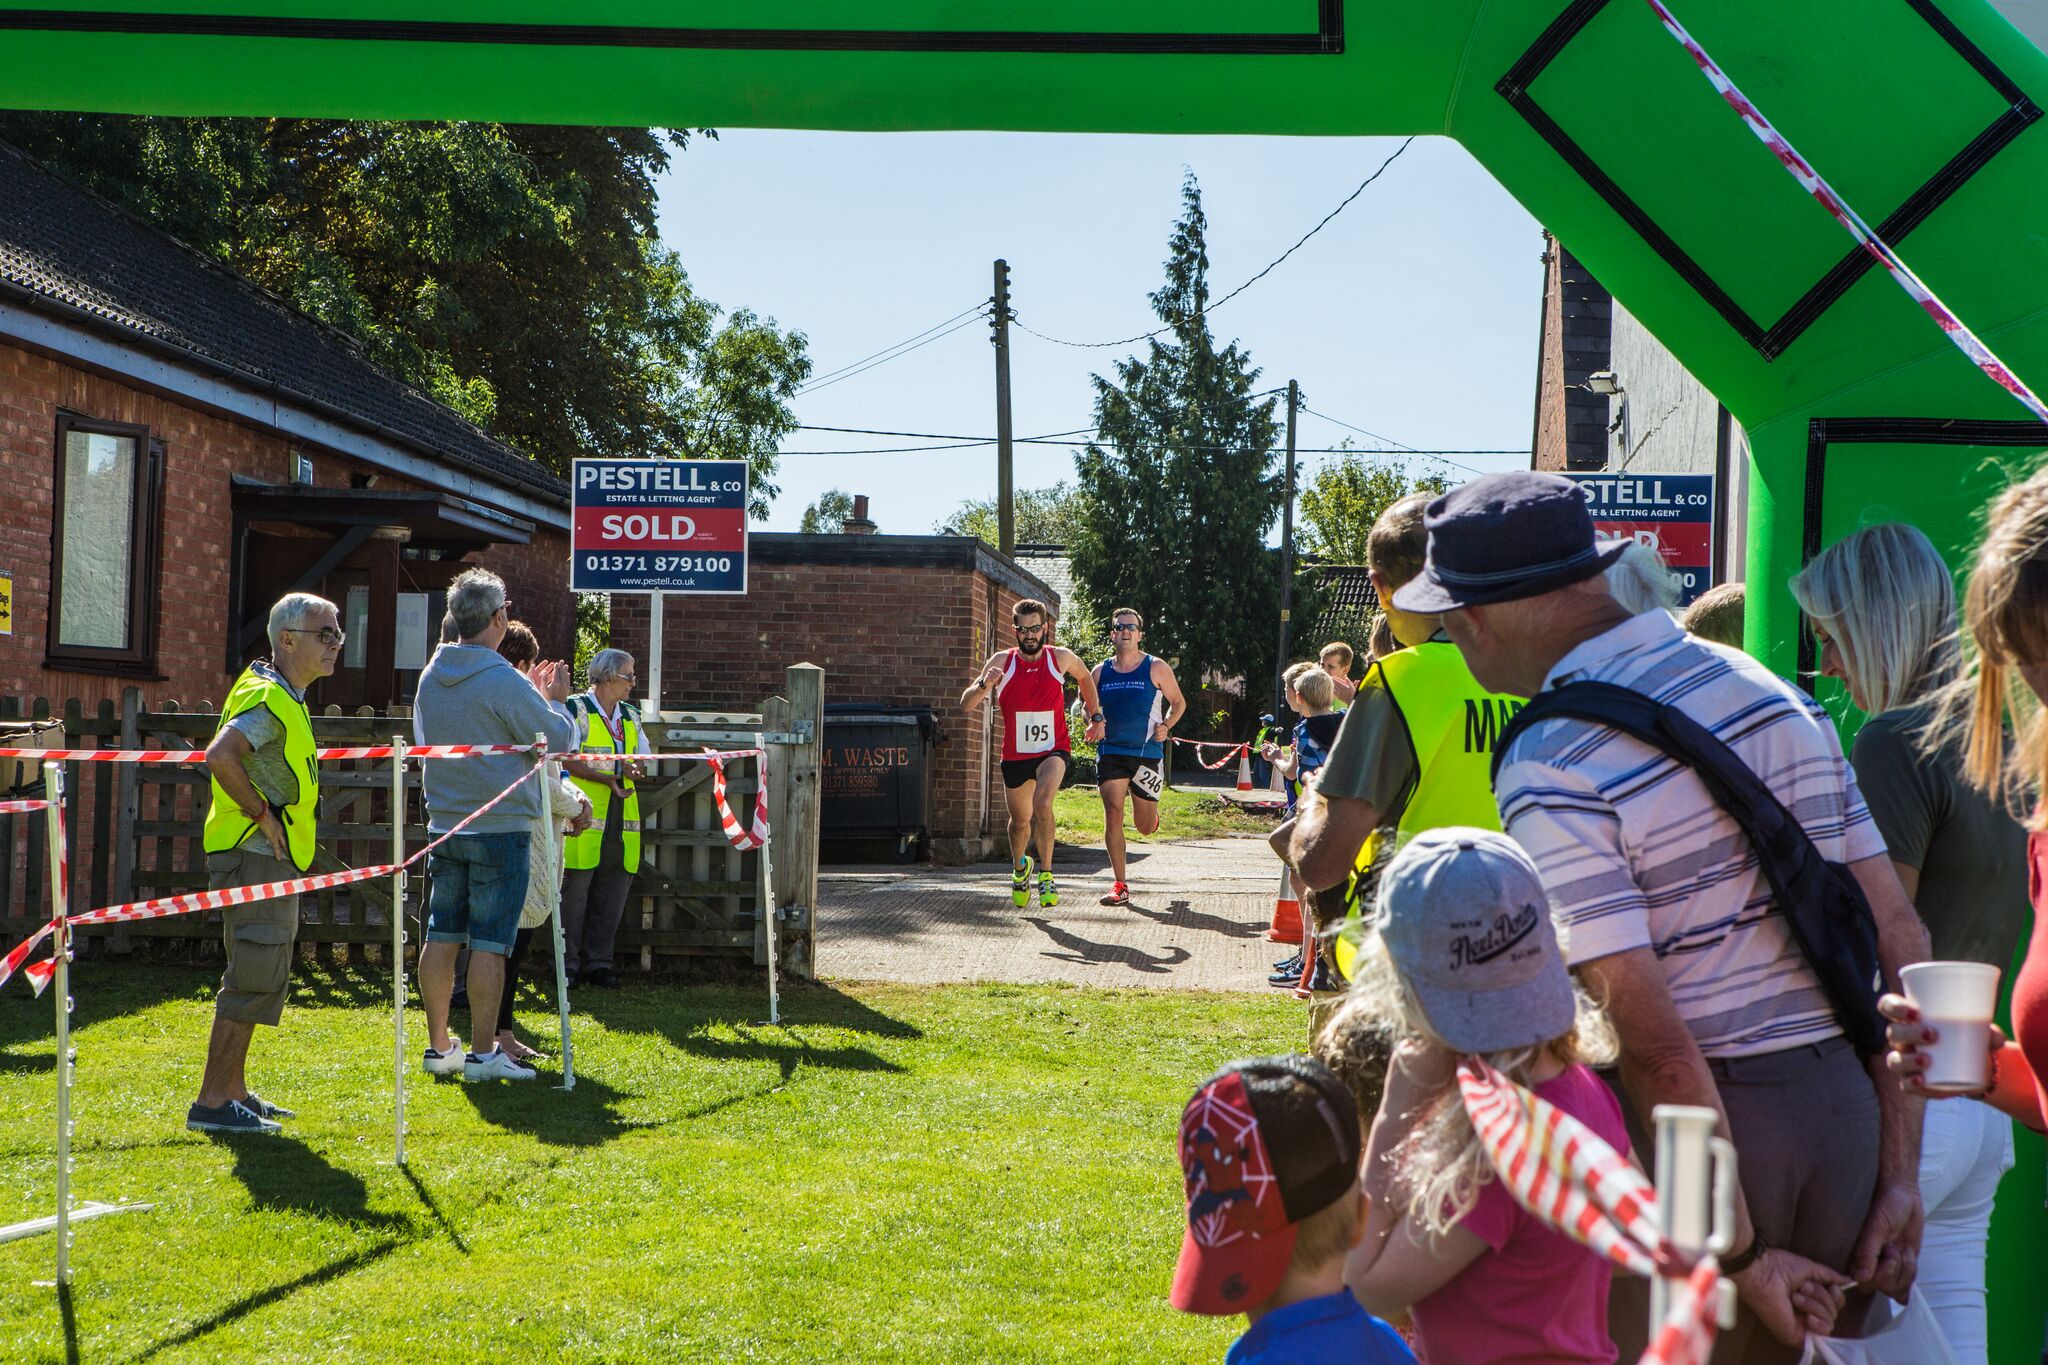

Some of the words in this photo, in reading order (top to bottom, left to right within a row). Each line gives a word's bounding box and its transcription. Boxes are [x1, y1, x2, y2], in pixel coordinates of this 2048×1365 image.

[580, 467, 706, 491] PESTELL
[710, 481, 720, 492] &
[722, 481, 741, 492] CO
[648, 495, 685, 503] LETTING
[1579, 481, 1670, 504] STELL
[1674, 495, 1685, 505] &
[1688, 495, 1707, 505] CO
[1610, 509, 1648, 517] LETTING
[1650, 509, 1681, 517] AGENT
[602, 515, 696, 540] SOLD
[586, 556, 647, 571] 01371
[654, 557, 731, 572] 879100
[620, 577, 695, 586] www.pestell.co.uk
[1024, 724, 1049, 742] 195
[844, 747, 909, 766] WASTE
[823, 775, 846, 789] 01371
[1138, 771, 1163, 794] 246
